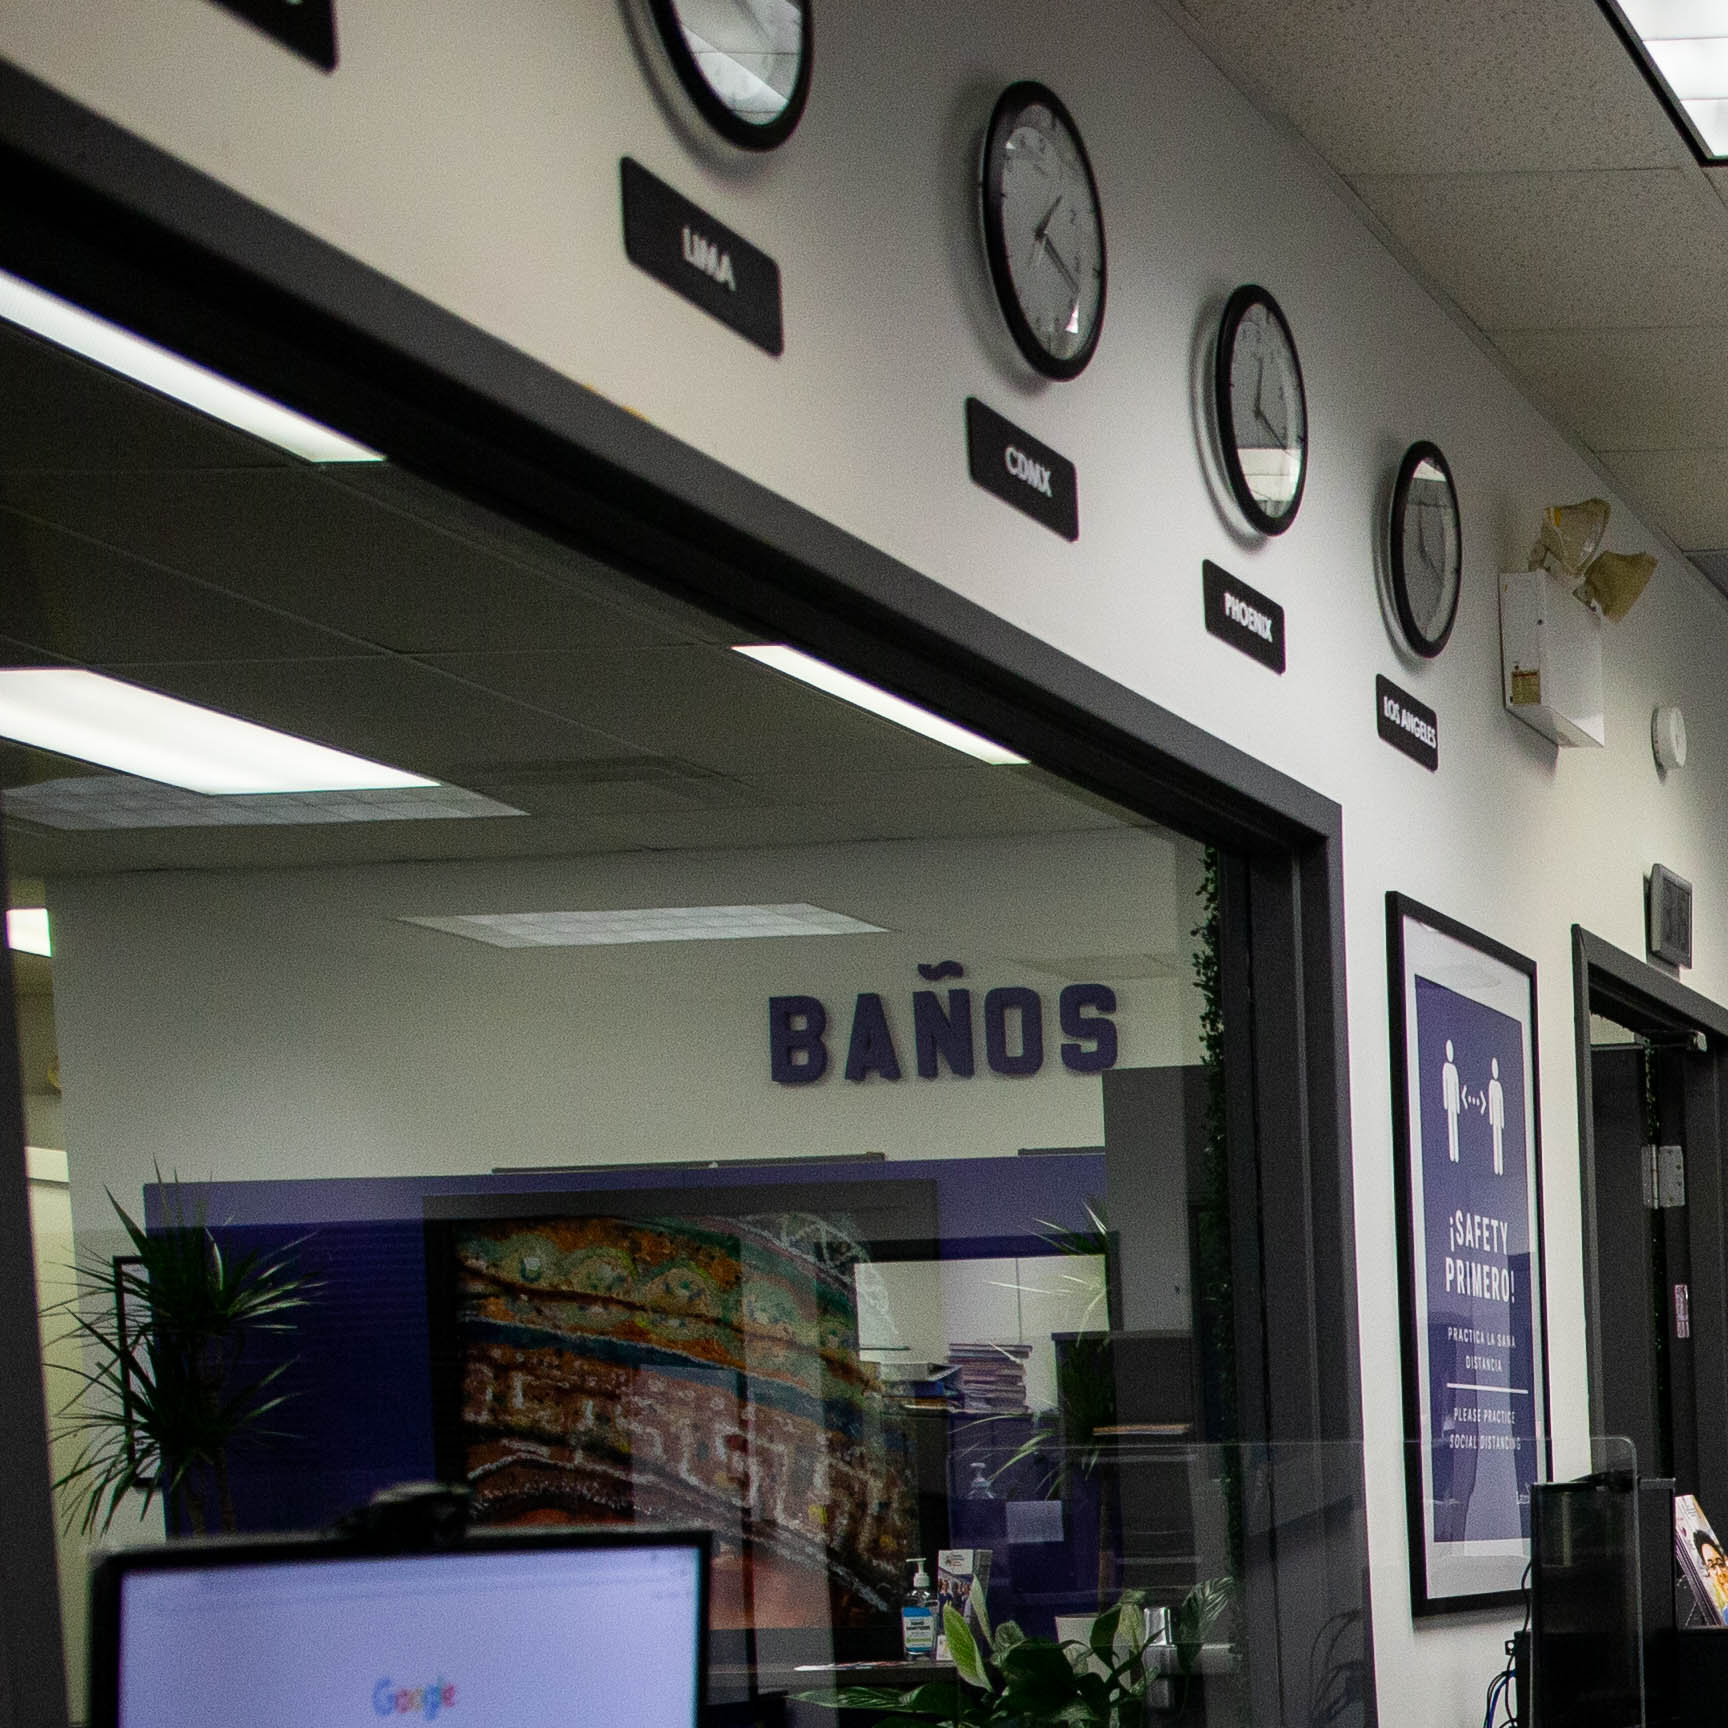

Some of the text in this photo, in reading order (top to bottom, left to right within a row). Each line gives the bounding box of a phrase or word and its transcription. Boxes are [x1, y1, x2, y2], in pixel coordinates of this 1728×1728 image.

[681, 225, 737, 293] LIMA
[1004, 445, 1054, 498] CDMX
[1223, 591, 1273, 644] PHOENIX
[1383, 695, 1437, 749] LOS ANGELES
[767, 959, 1118, 1085] BAÑOS
[1449, 1208, 1509, 1256] ¡SAFETY
[1445, 1256, 1516, 1304] PRIMERO!
[1447, 1326, 1485, 1346] PRACTICA
[1465, 1355, 1503, 1372] DISTANCIA
[1453, 1407, 1516, 1425] PLEASE PRACTICE
[1449, 1434, 1522, 1451] SOCIAL DISTANCING
[372, 1674, 457, 1721] Google
